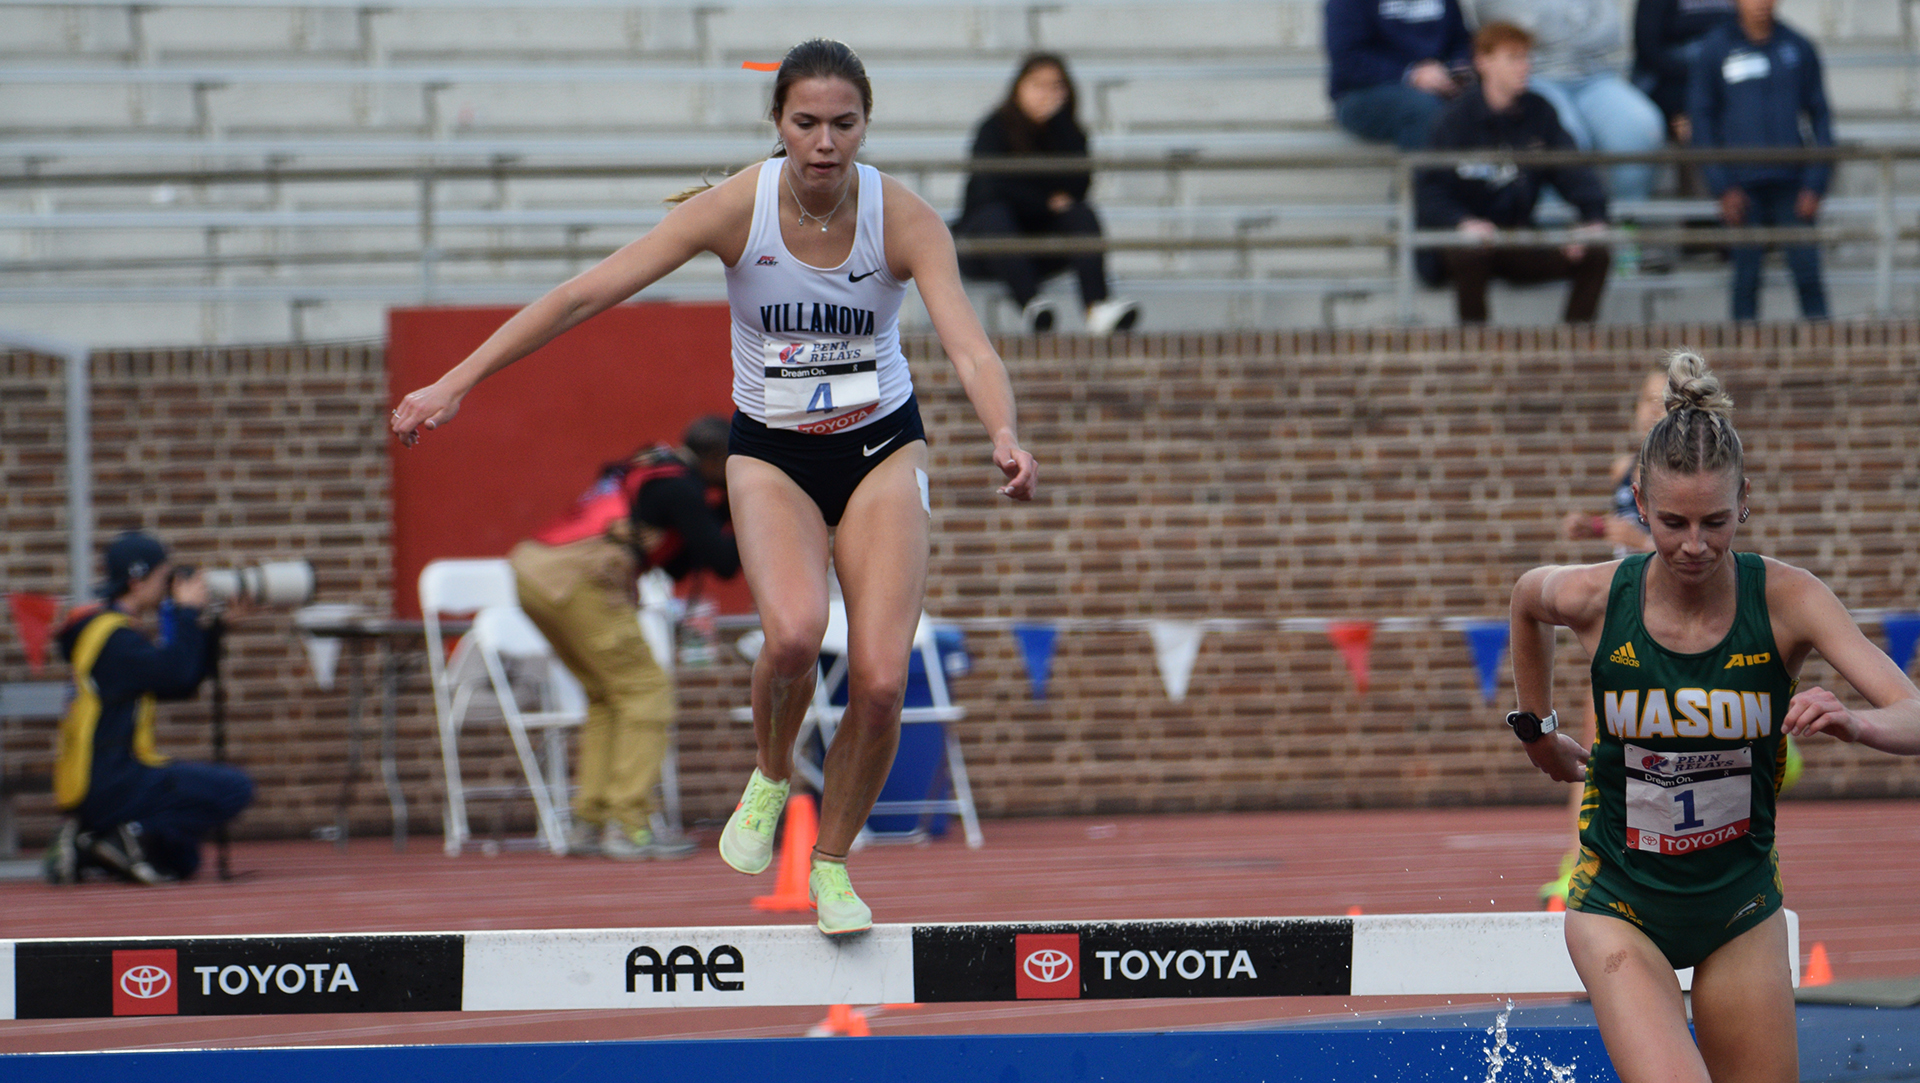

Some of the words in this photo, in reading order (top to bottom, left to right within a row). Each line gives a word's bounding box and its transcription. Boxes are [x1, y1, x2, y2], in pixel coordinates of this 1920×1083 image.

[760, 302, 875, 336] VILLANOVA
[809, 349, 861, 363] RELAYS
[812, 341, 850, 353] PENN
[781, 369, 811, 378] Dream
[811, 368, 827, 376] On.
[806, 382, 838, 414] 4
[802, 410, 868, 433] TOYOTA
[1609, 654, 1640, 668] adidas
[1723, 652, 1771, 669] A10
[1604, 687, 1772, 740] MASON
[1674, 760, 1735, 772] RELAYS
[1677, 754, 1721, 764] PENN
[1644, 773, 1675, 787] Dream
[1676, 776, 1694, 784] On.
[1674, 789, 1704, 832] 1
[1664, 826, 1738, 851] TOYOTA
[1095, 950, 1258, 980] TOYOTA
[194, 963, 359, 995] TOYOTA
